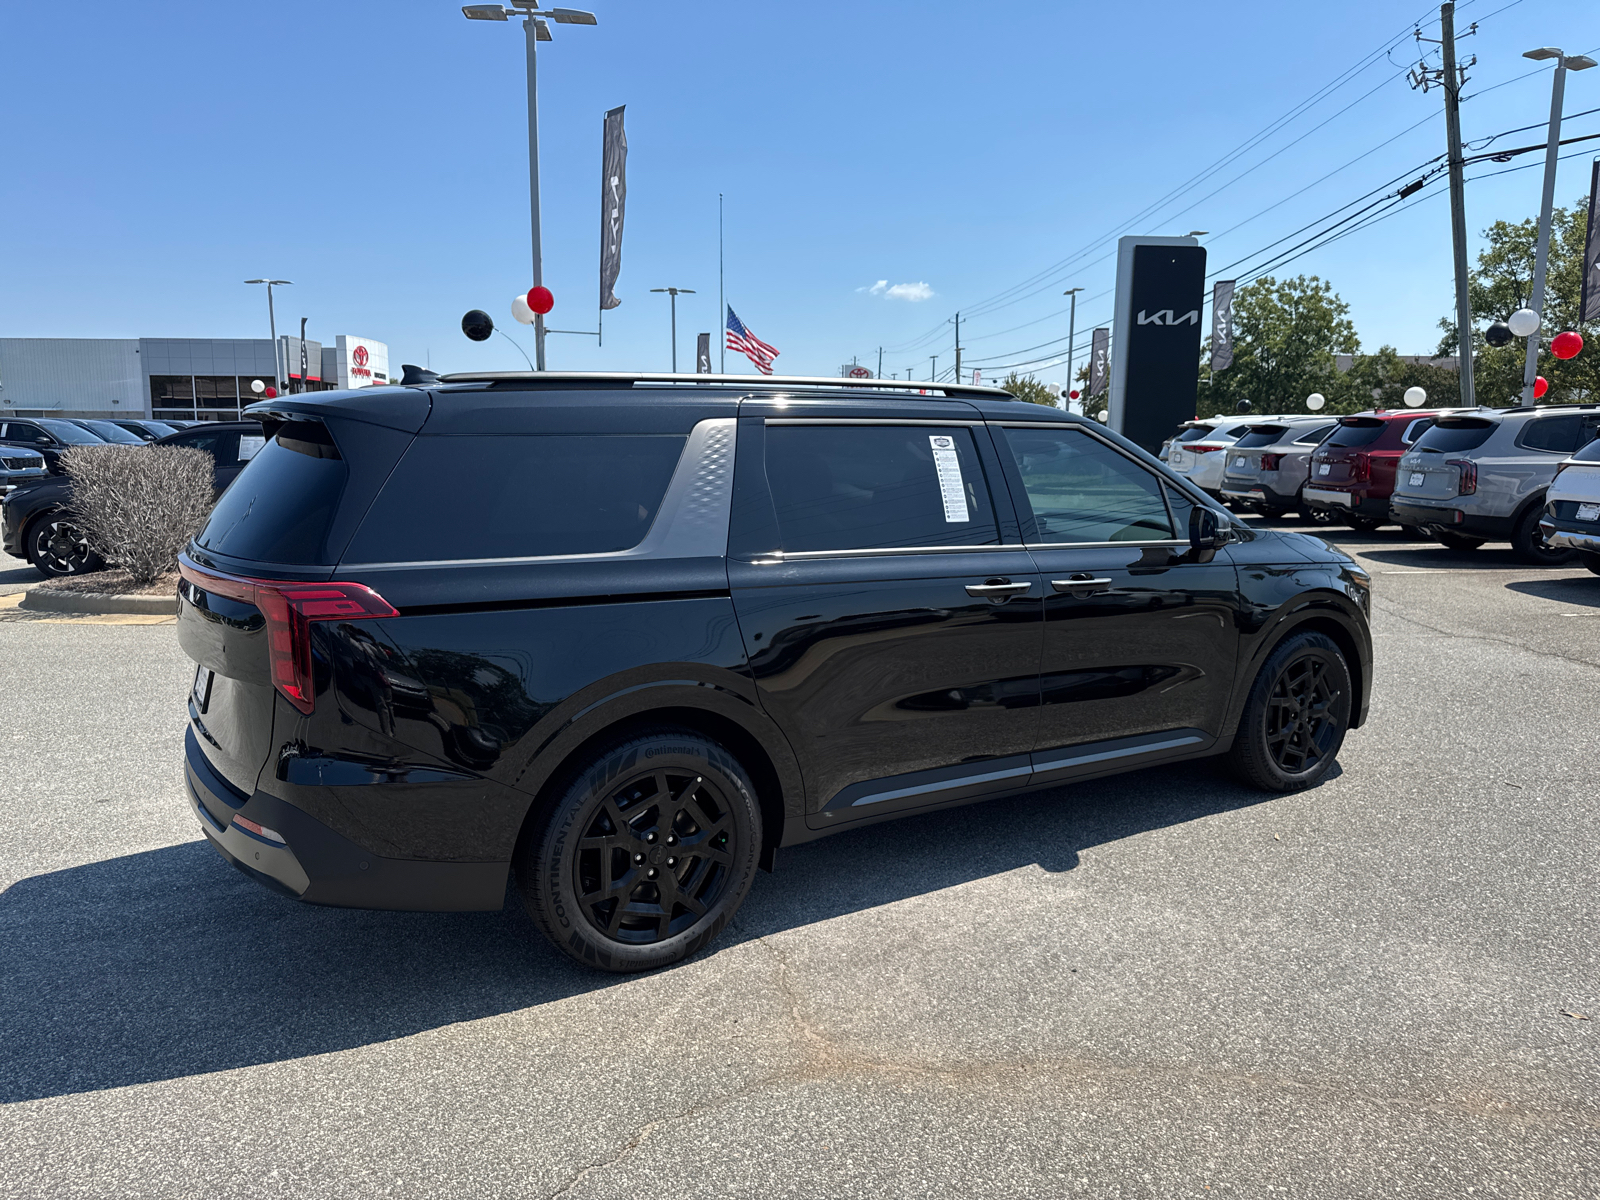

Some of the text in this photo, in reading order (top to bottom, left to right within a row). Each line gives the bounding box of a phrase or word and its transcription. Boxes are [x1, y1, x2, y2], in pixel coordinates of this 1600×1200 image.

[1137, 309, 1199, 326] KIA
[1217, 310, 1227, 345] KIA
[352, 367, 371, 377] TOYOTA
[1096, 349, 1105, 377] KIA
[645, 745, 695, 759] Continental
[550, 797, 588, 929] CONTINENTAL
